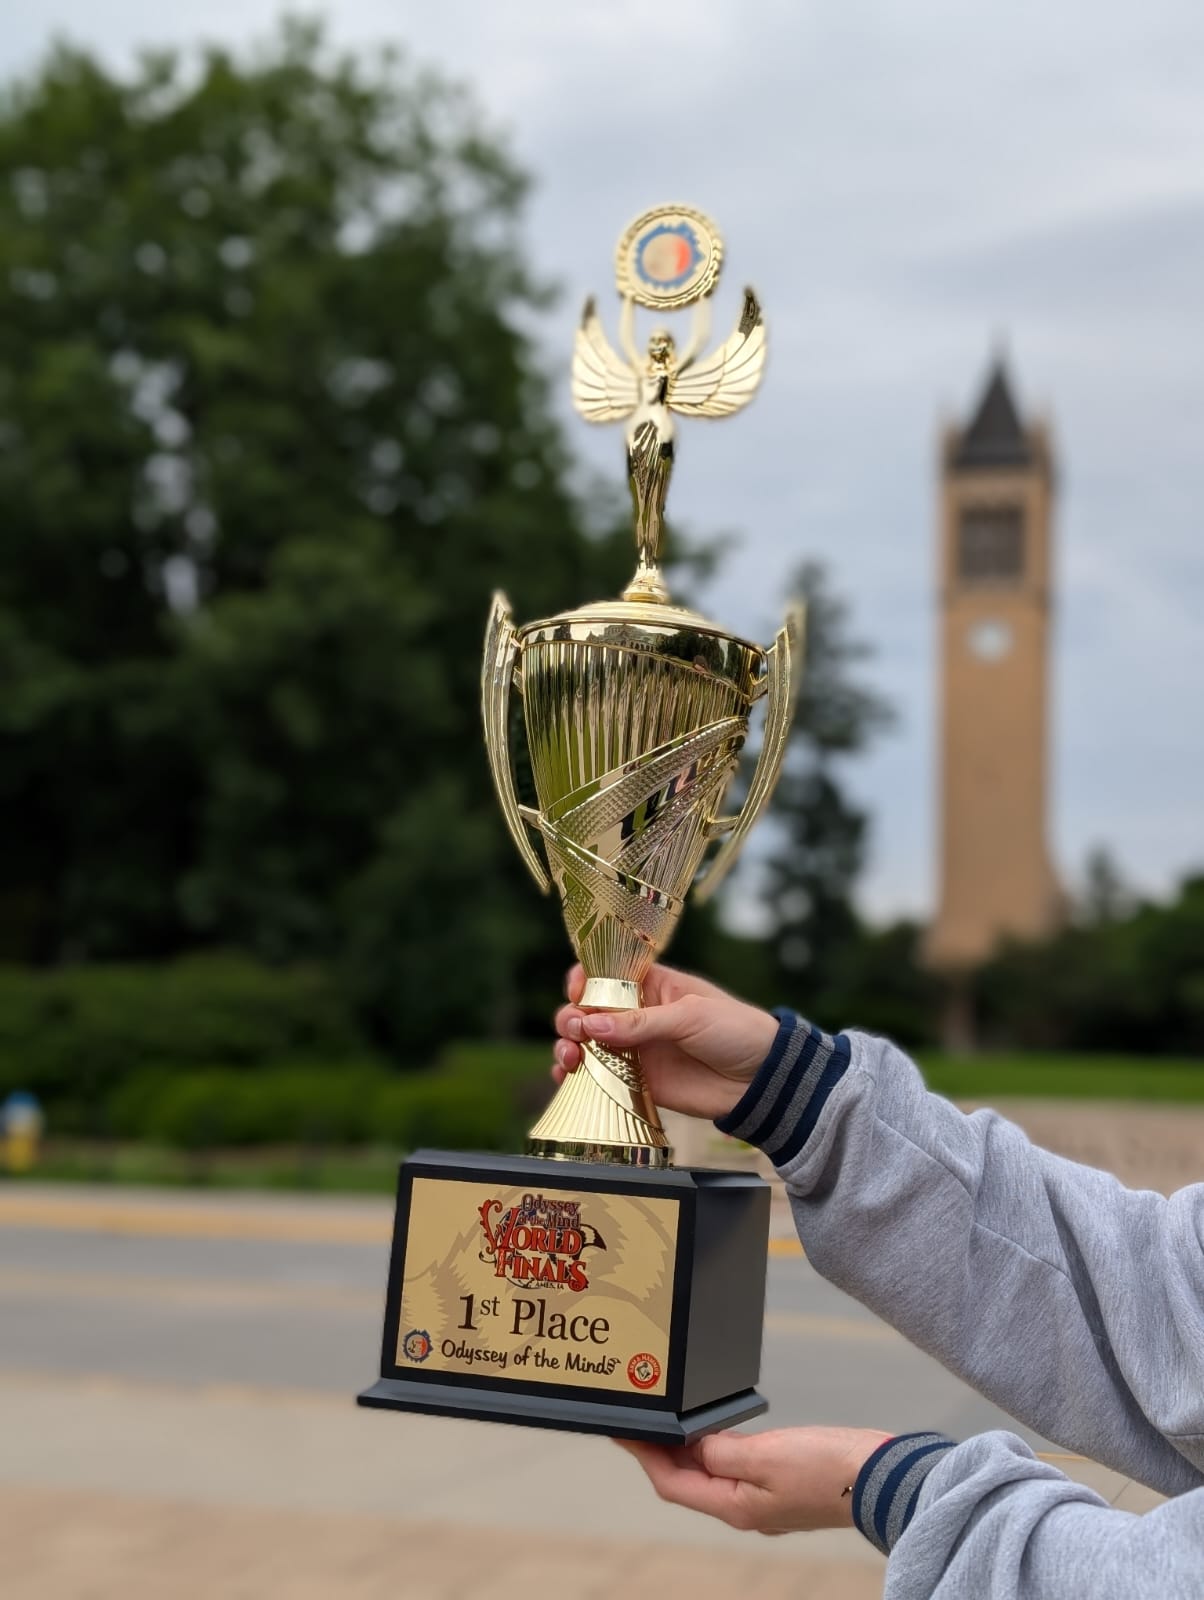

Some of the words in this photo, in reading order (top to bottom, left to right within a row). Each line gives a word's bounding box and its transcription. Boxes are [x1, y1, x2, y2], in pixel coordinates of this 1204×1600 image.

[522, 1194, 581, 1216] Odyssey
[546, 1210, 581, 1229] Mind
[478, 1199, 583, 1257] WORLD
[495, 1247, 590, 1292] FINALS
[457, 1293, 500, 1331] 1st
[509, 1298, 610, 1345] Place
[441, 1339, 508, 1369] Odyssey
[513, 1345, 534, 1366] of
[534, 1348, 560, 1369] the
